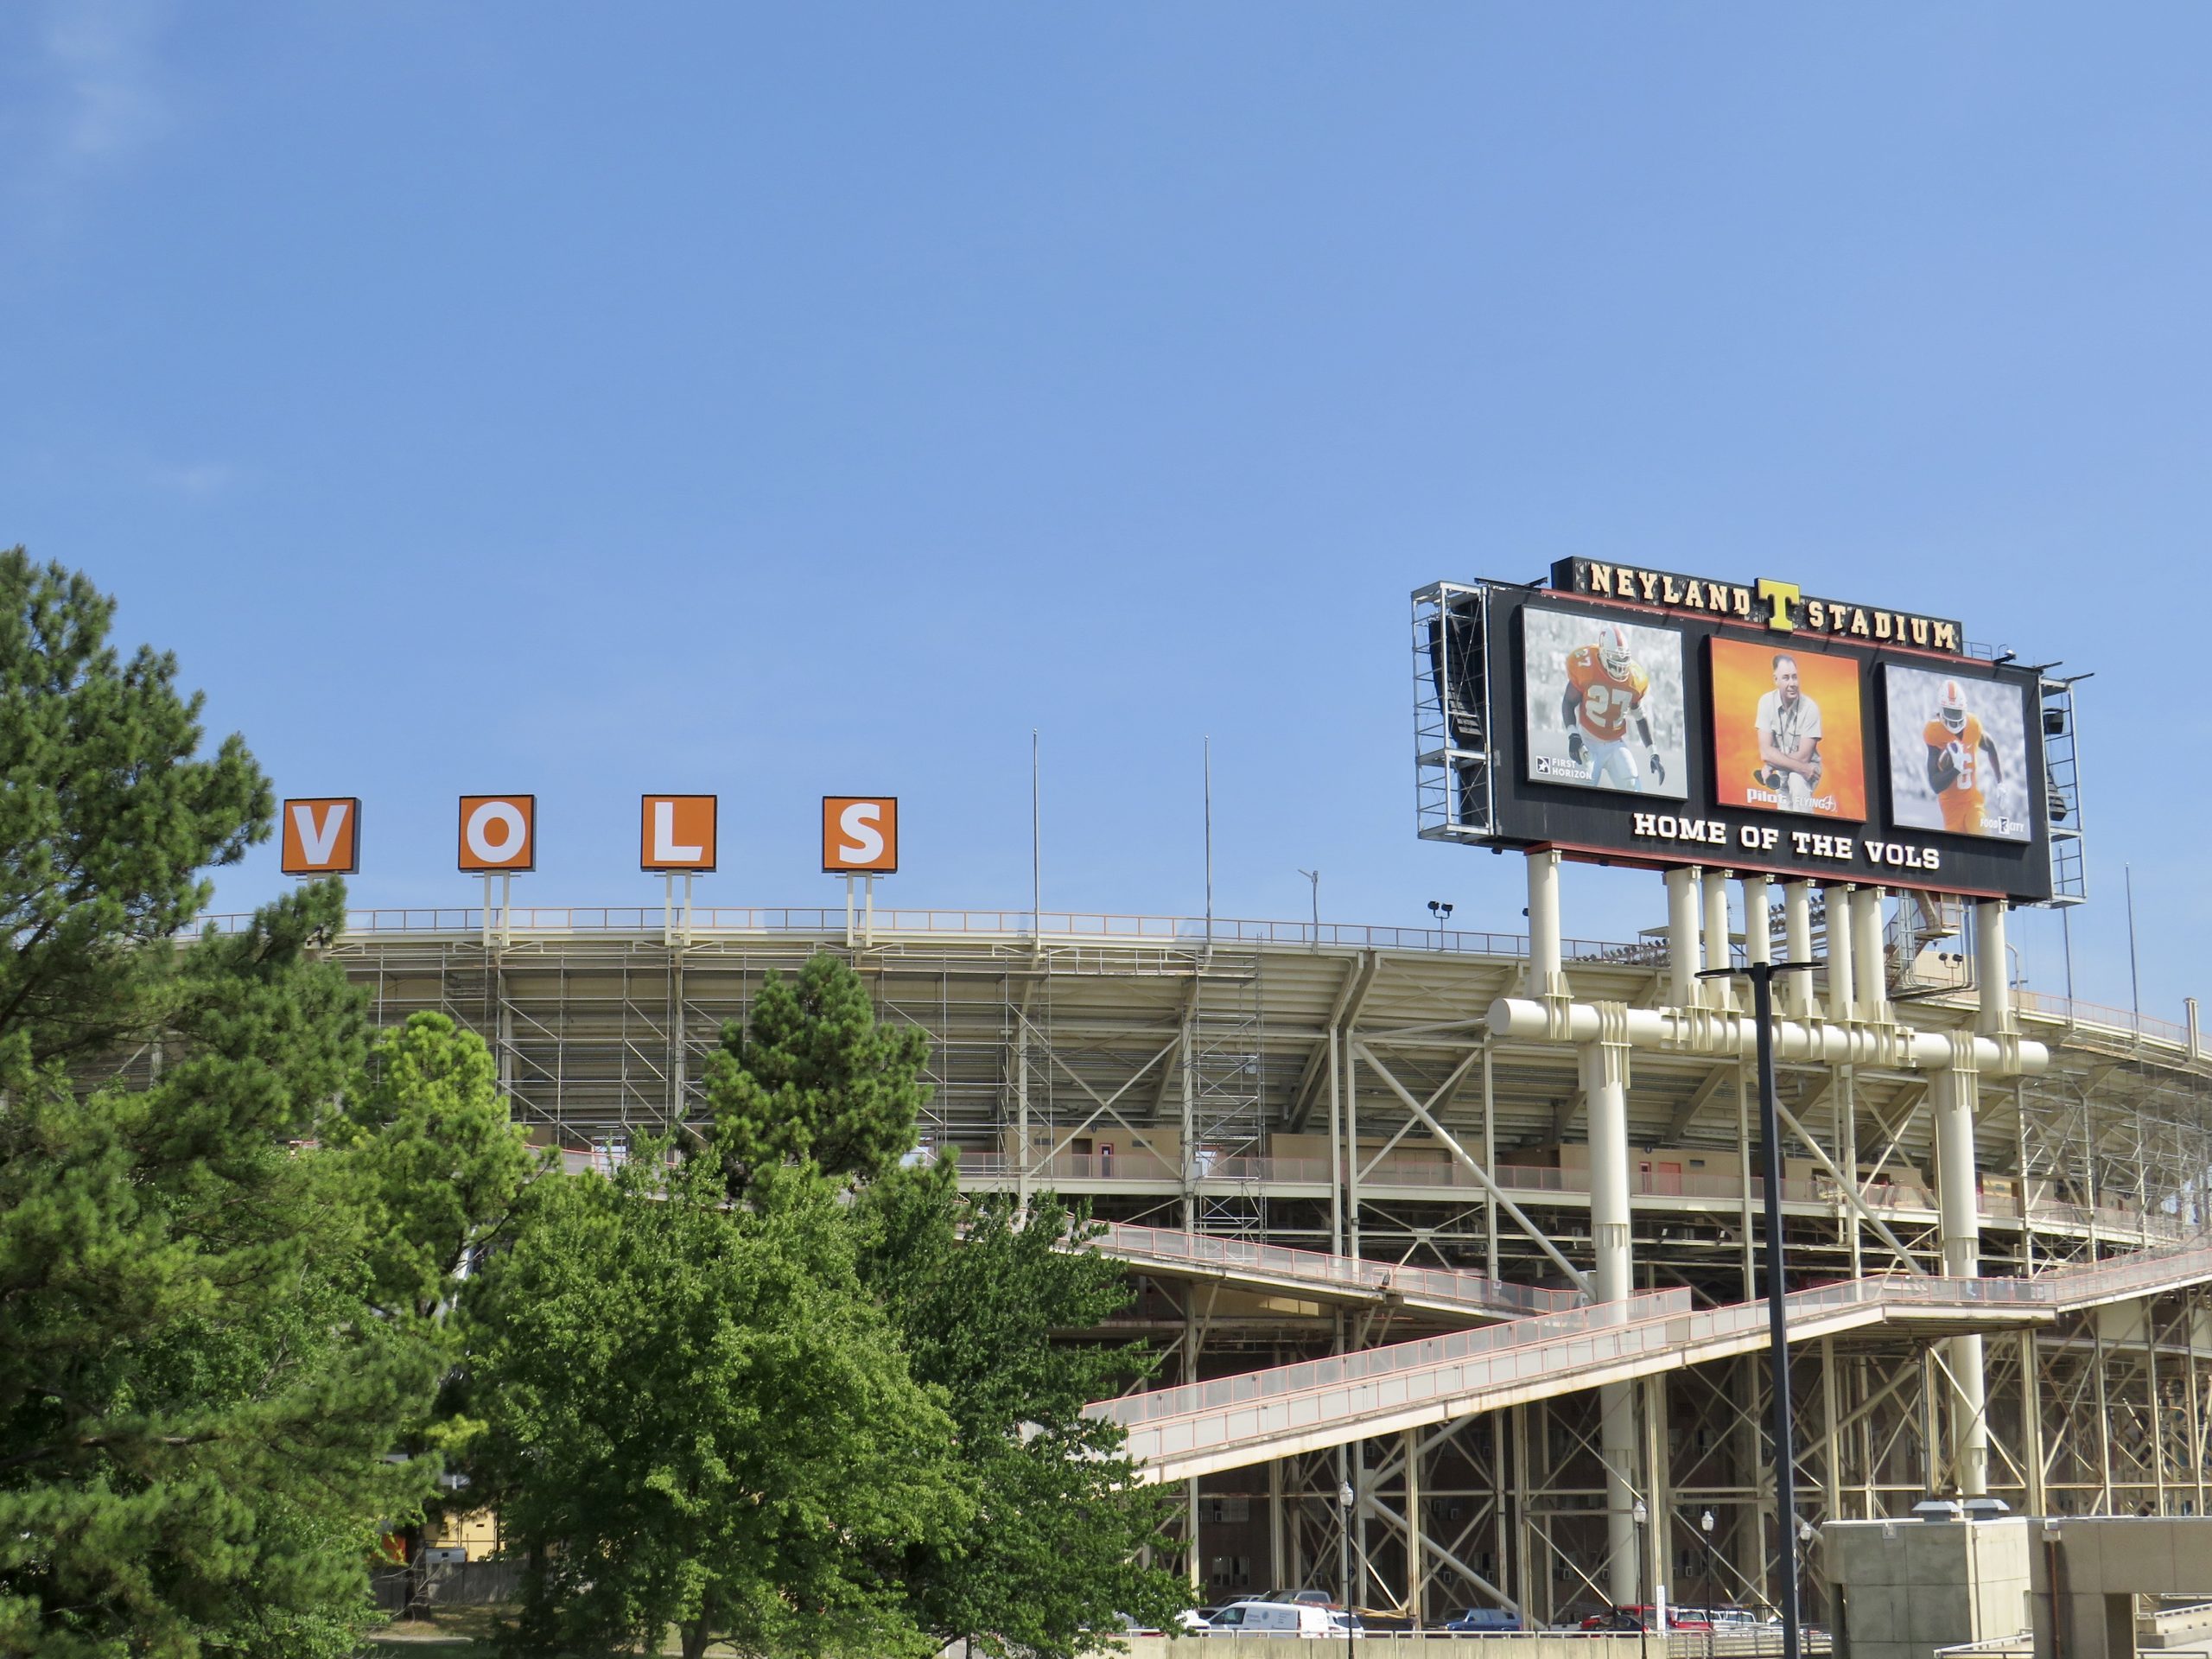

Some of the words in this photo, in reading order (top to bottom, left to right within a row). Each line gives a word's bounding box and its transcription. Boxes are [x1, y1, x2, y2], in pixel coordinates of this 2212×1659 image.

[1590, 563, 1750, 615] NEYLAND
[1757, 578, 1800, 632] T
[1808, 601, 1955, 650] STADIUM
[1586, 684, 1633, 729] 27
[1552, 758, 1577, 768] FIRST
[1552, 767, 1592, 780] HORIZON
[1795, 794, 1825, 810] FLYING
[1633, 812, 1726, 844] HOME
[1740, 825, 1779, 849] OF
[1792, 831, 1853, 860] THE
[1864, 840, 1940, 870] VOLS
